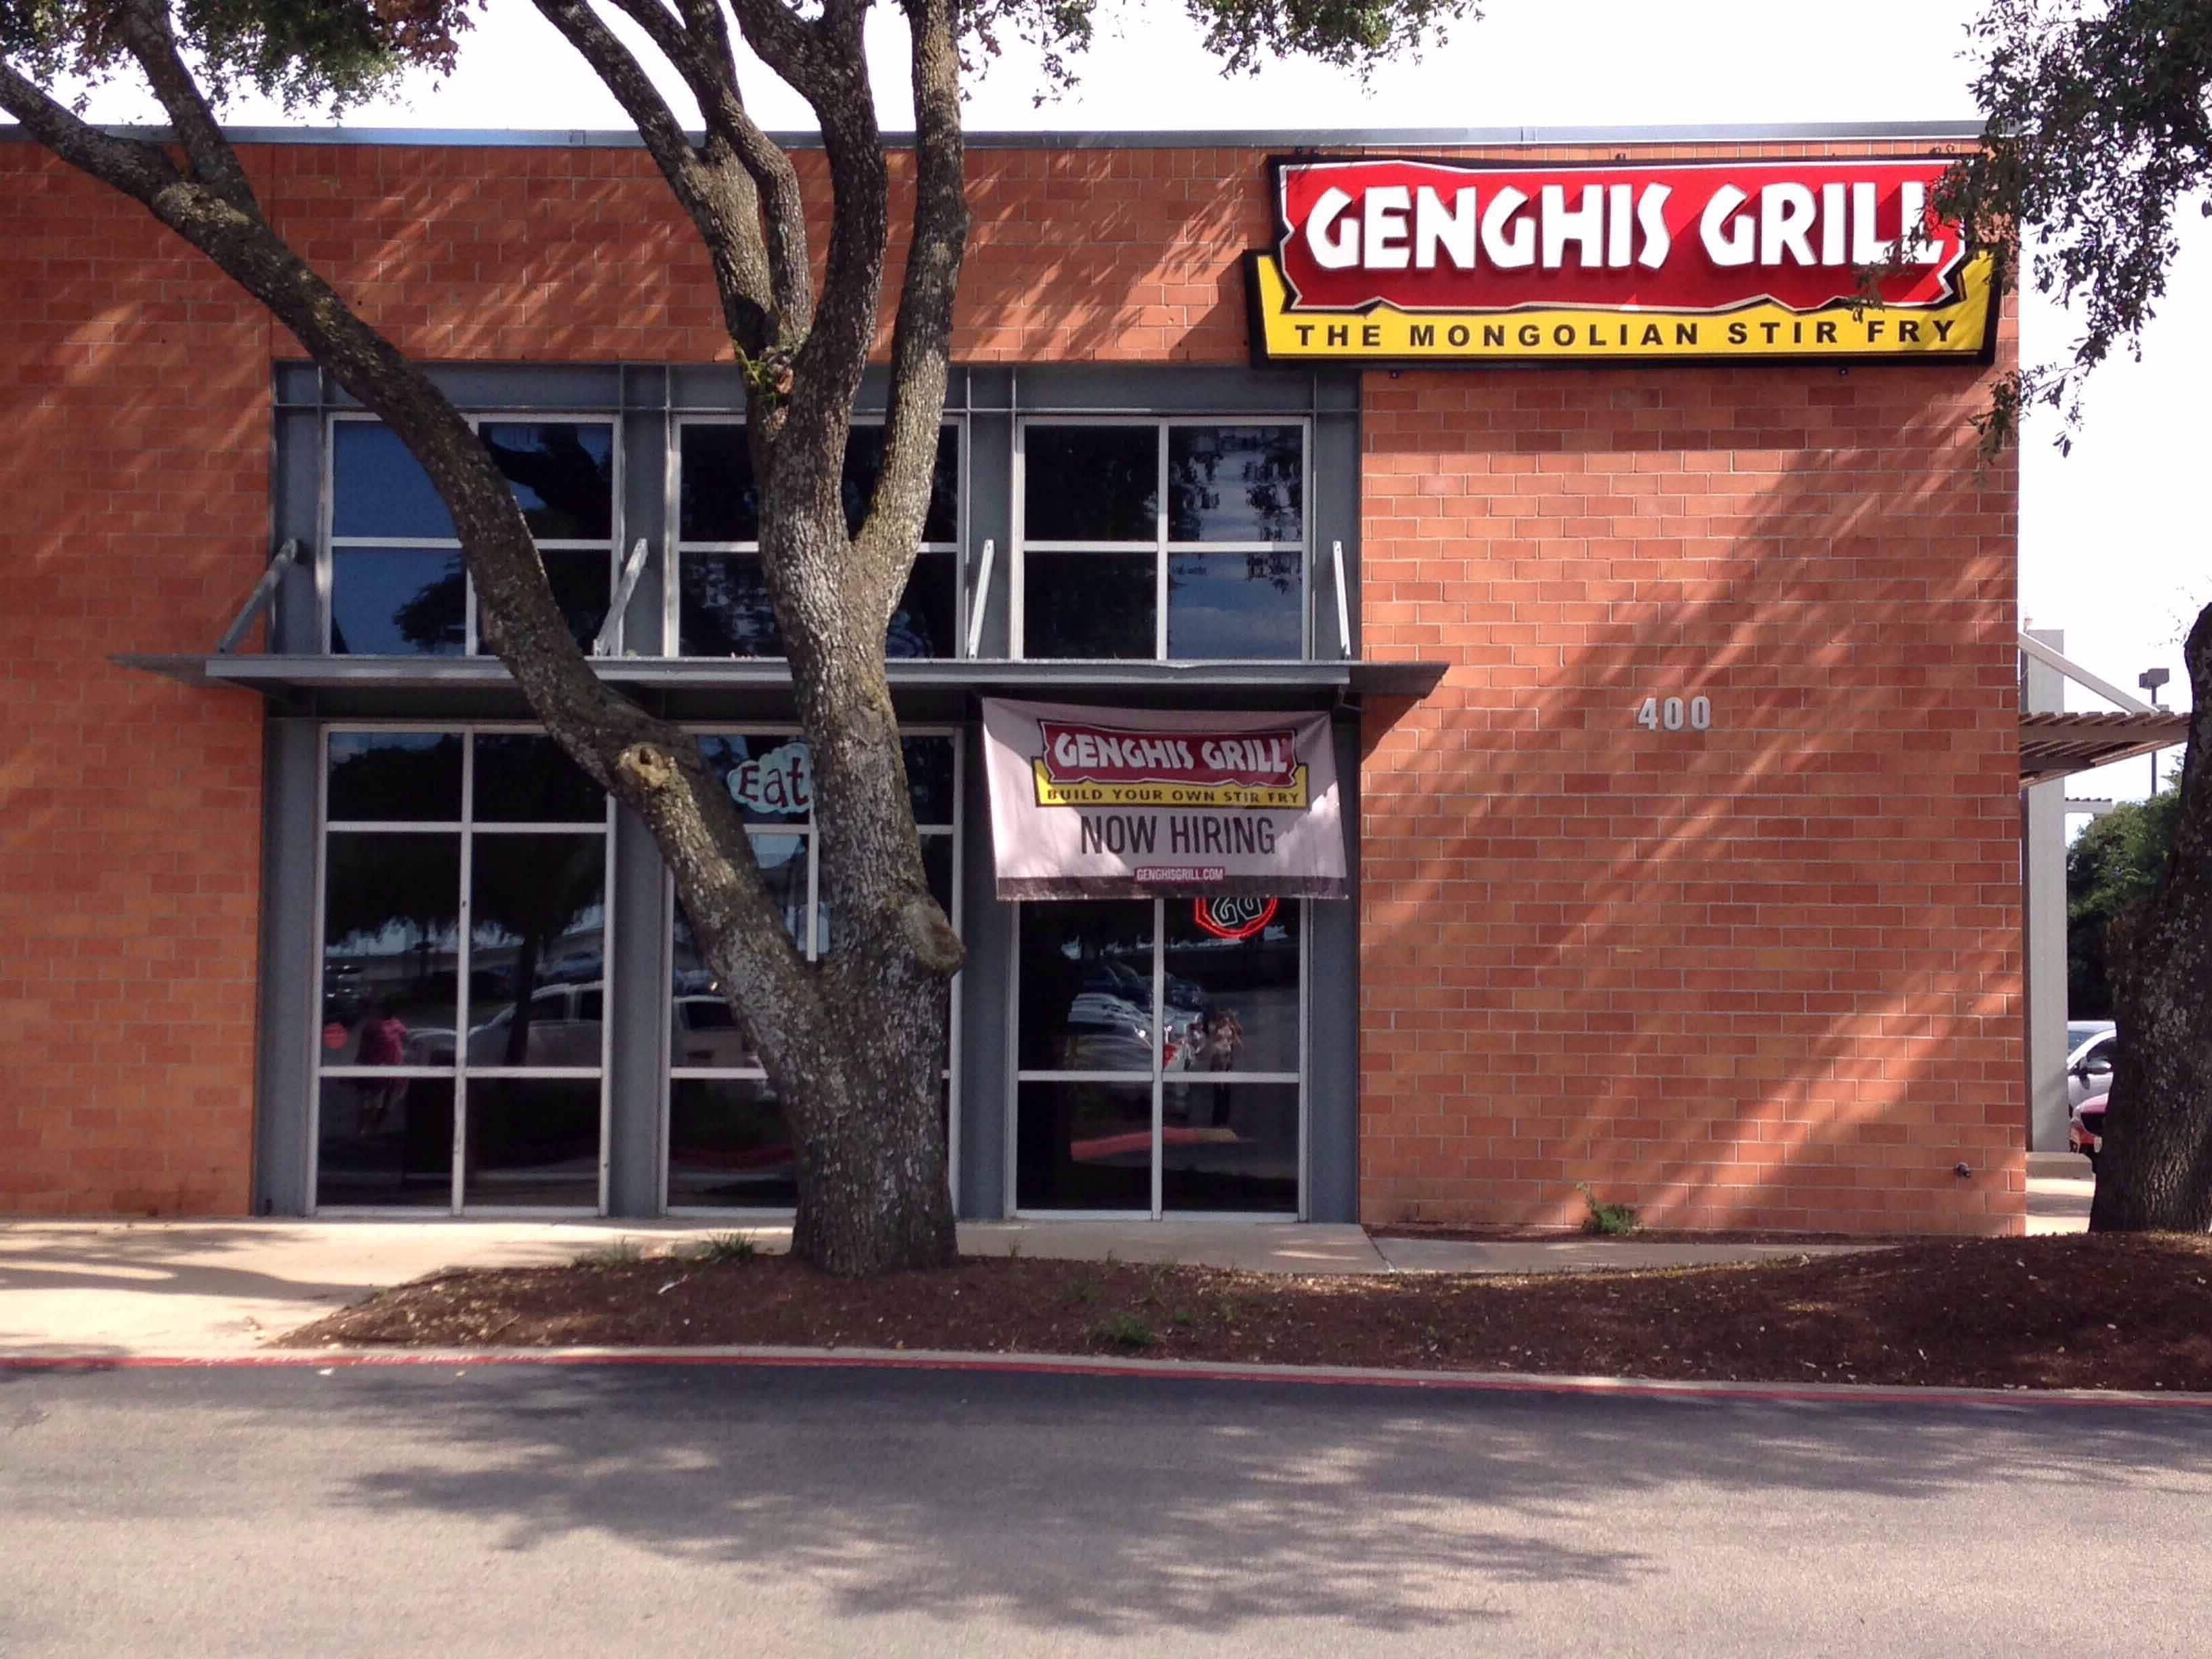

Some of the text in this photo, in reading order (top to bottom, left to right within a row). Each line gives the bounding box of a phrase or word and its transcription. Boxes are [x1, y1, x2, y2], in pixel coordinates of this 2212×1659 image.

[1305, 182, 1945, 270] GENGHIS GRILL
[1295, 320, 1955, 347] THE MONGOLIAN STIR FRY
[1637, 696, 1711, 731] 400
[1054, 733, 1287, 773] GENGHIS GRILL
[739, 757, 809, 807] Eat
[1048, 789, 1300, 804] BUILD YOUR OWN STIR FRY
[1081, 815, 1275, 855] NOW HIRING
[1136, 867, 1224, 881] GENGHISGRILL.COM
